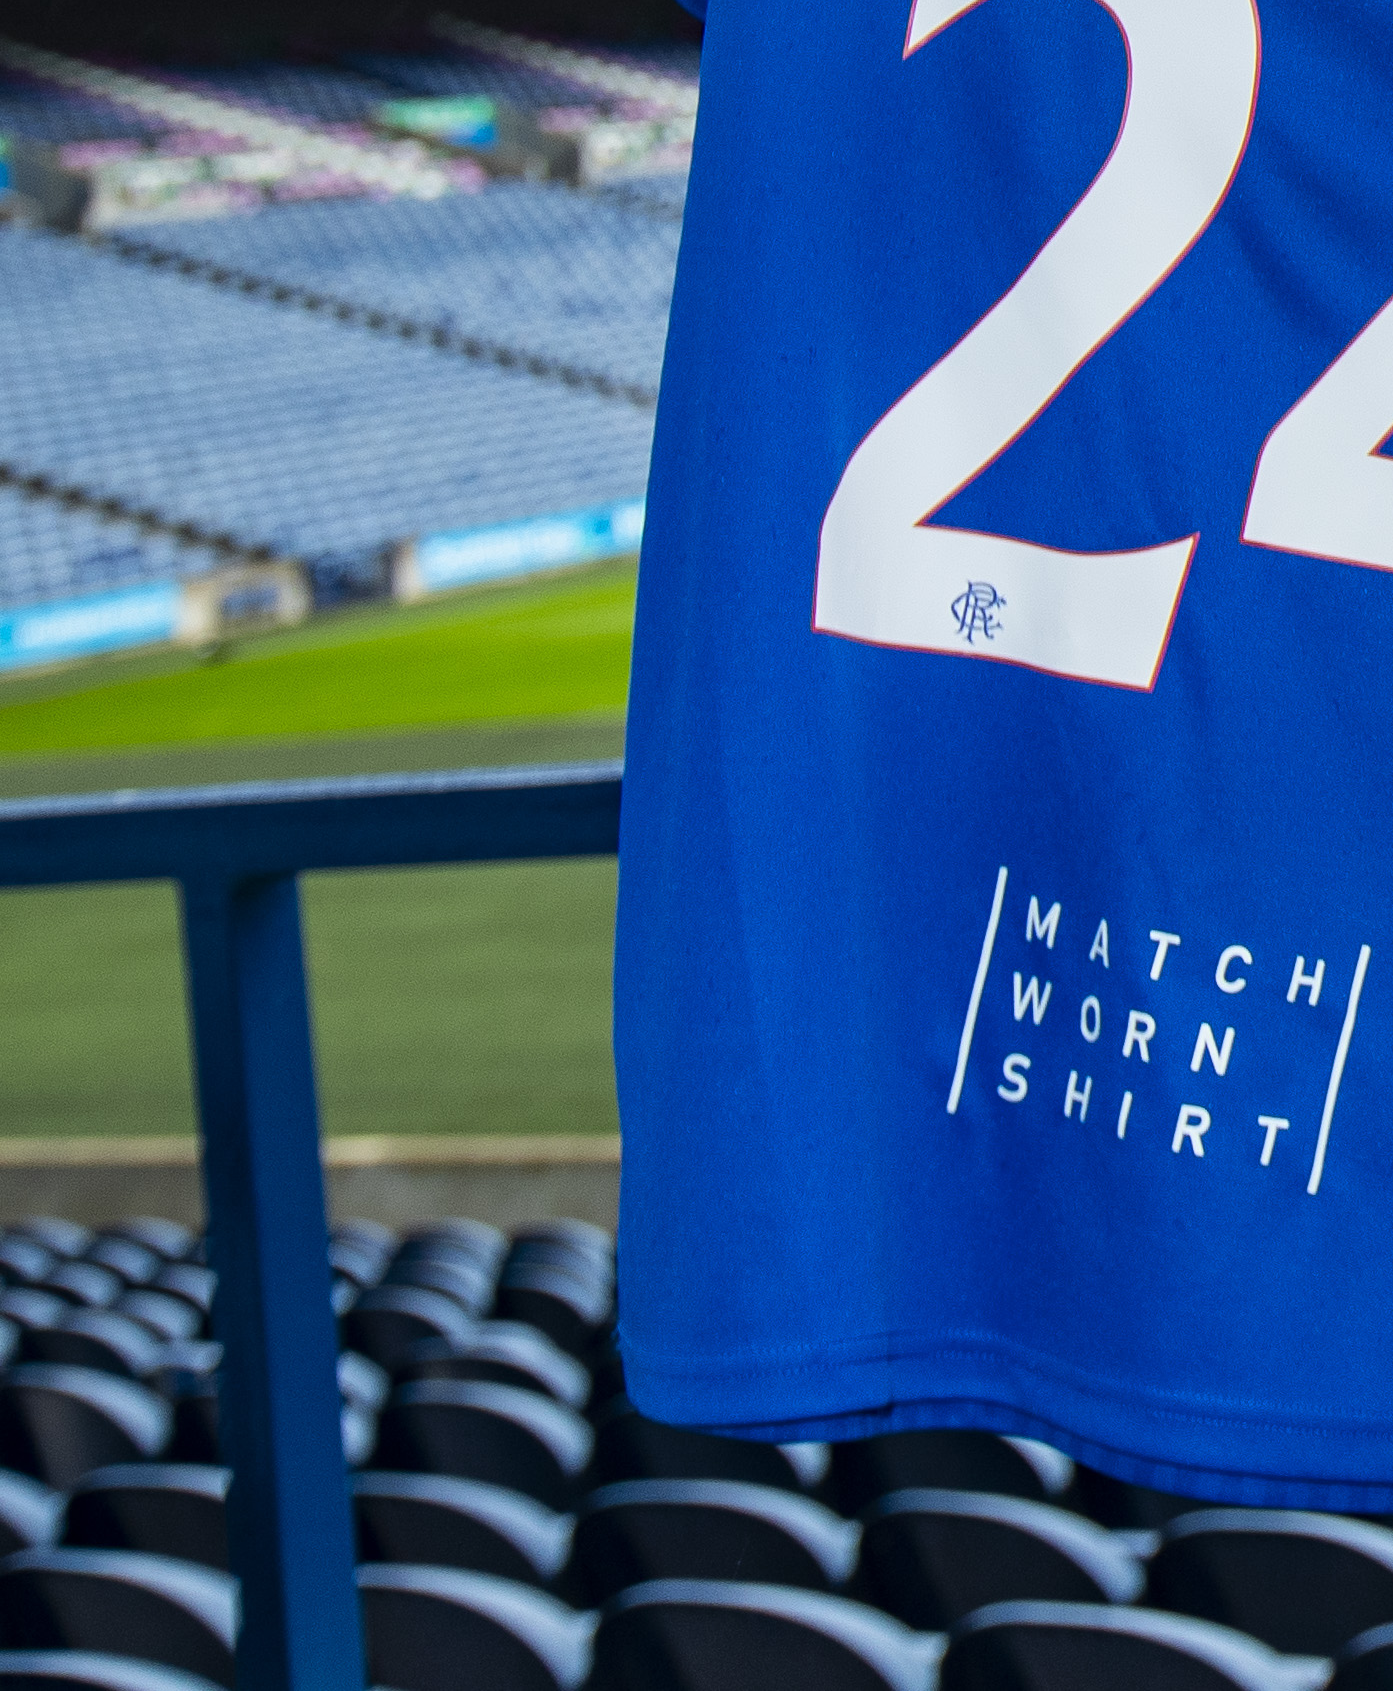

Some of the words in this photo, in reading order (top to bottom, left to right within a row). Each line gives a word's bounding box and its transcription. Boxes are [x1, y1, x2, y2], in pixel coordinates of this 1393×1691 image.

[1025, 895, 1326, 1007] MATCH
[1012, 971, 1236, 1077] WORN
[996, 1052, 1291, 1167] SHIRT
